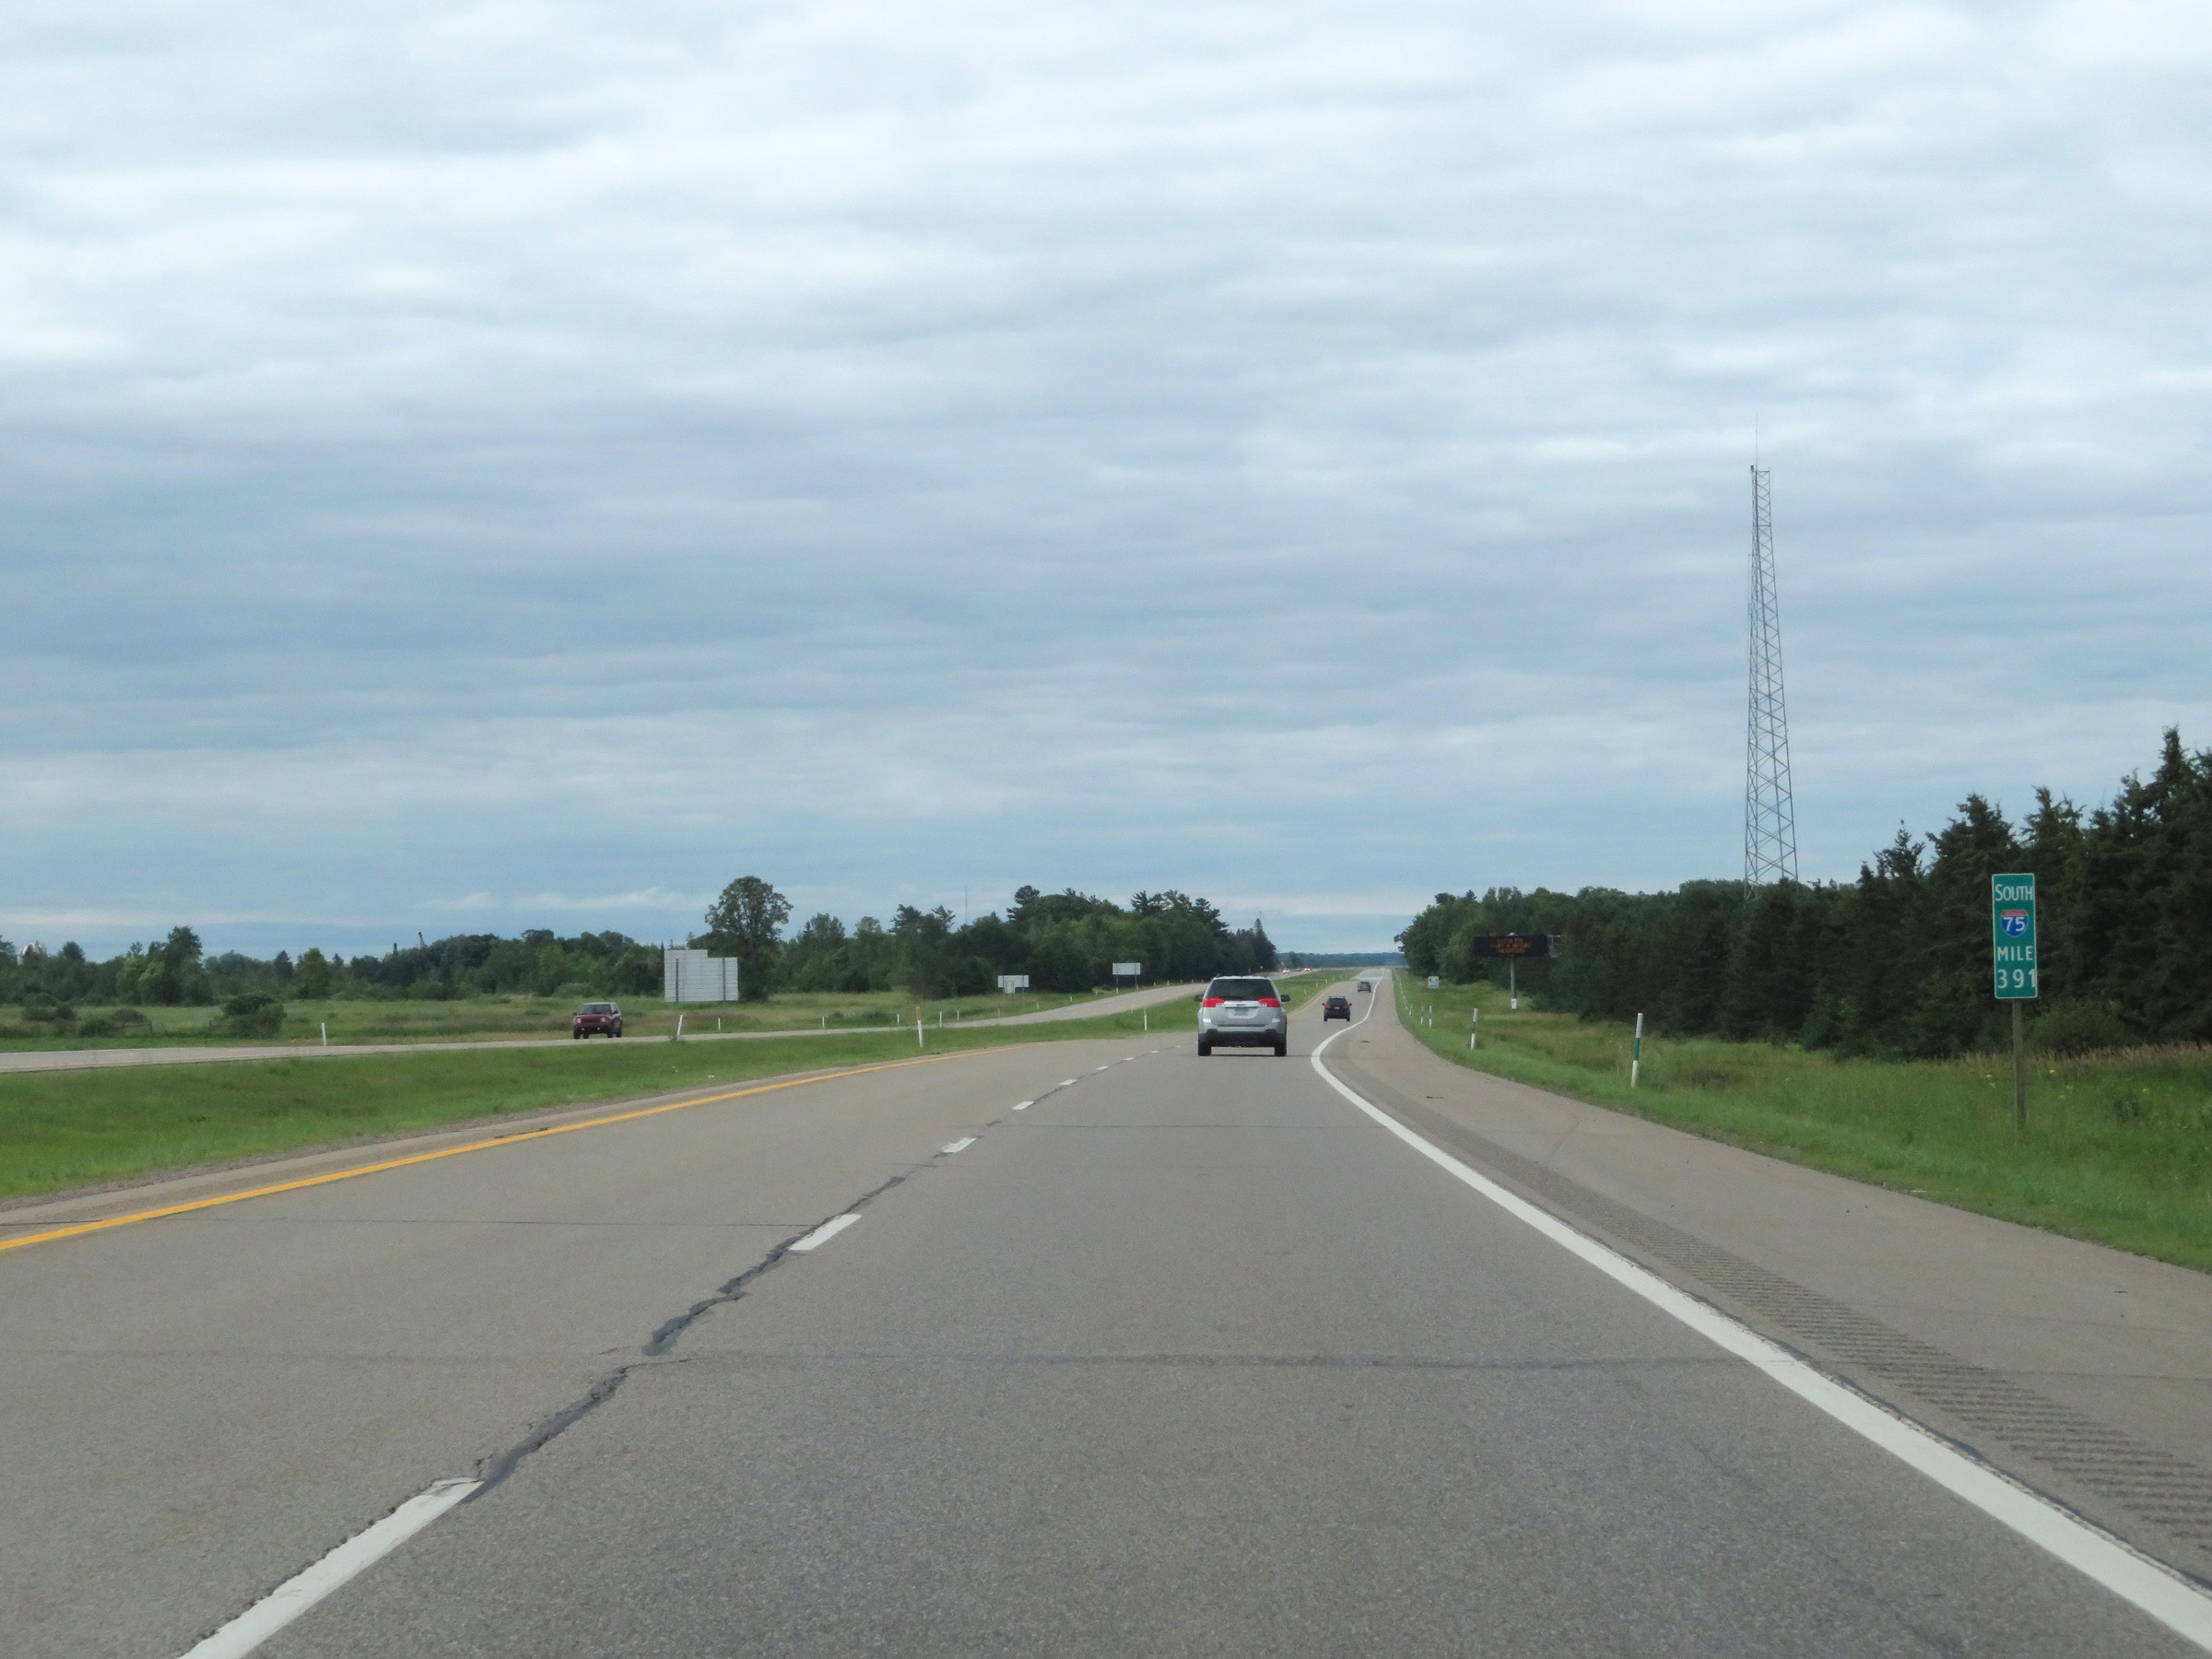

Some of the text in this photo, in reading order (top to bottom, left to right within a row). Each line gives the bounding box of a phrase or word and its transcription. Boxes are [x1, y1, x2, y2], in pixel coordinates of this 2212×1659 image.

[1994, 884, 2033, 901] SOUTH
[2003, 916, 2026, 932] 75
[1997, 946, 2033, 961] MILE
[1997, 969, 2036, 989] 391
